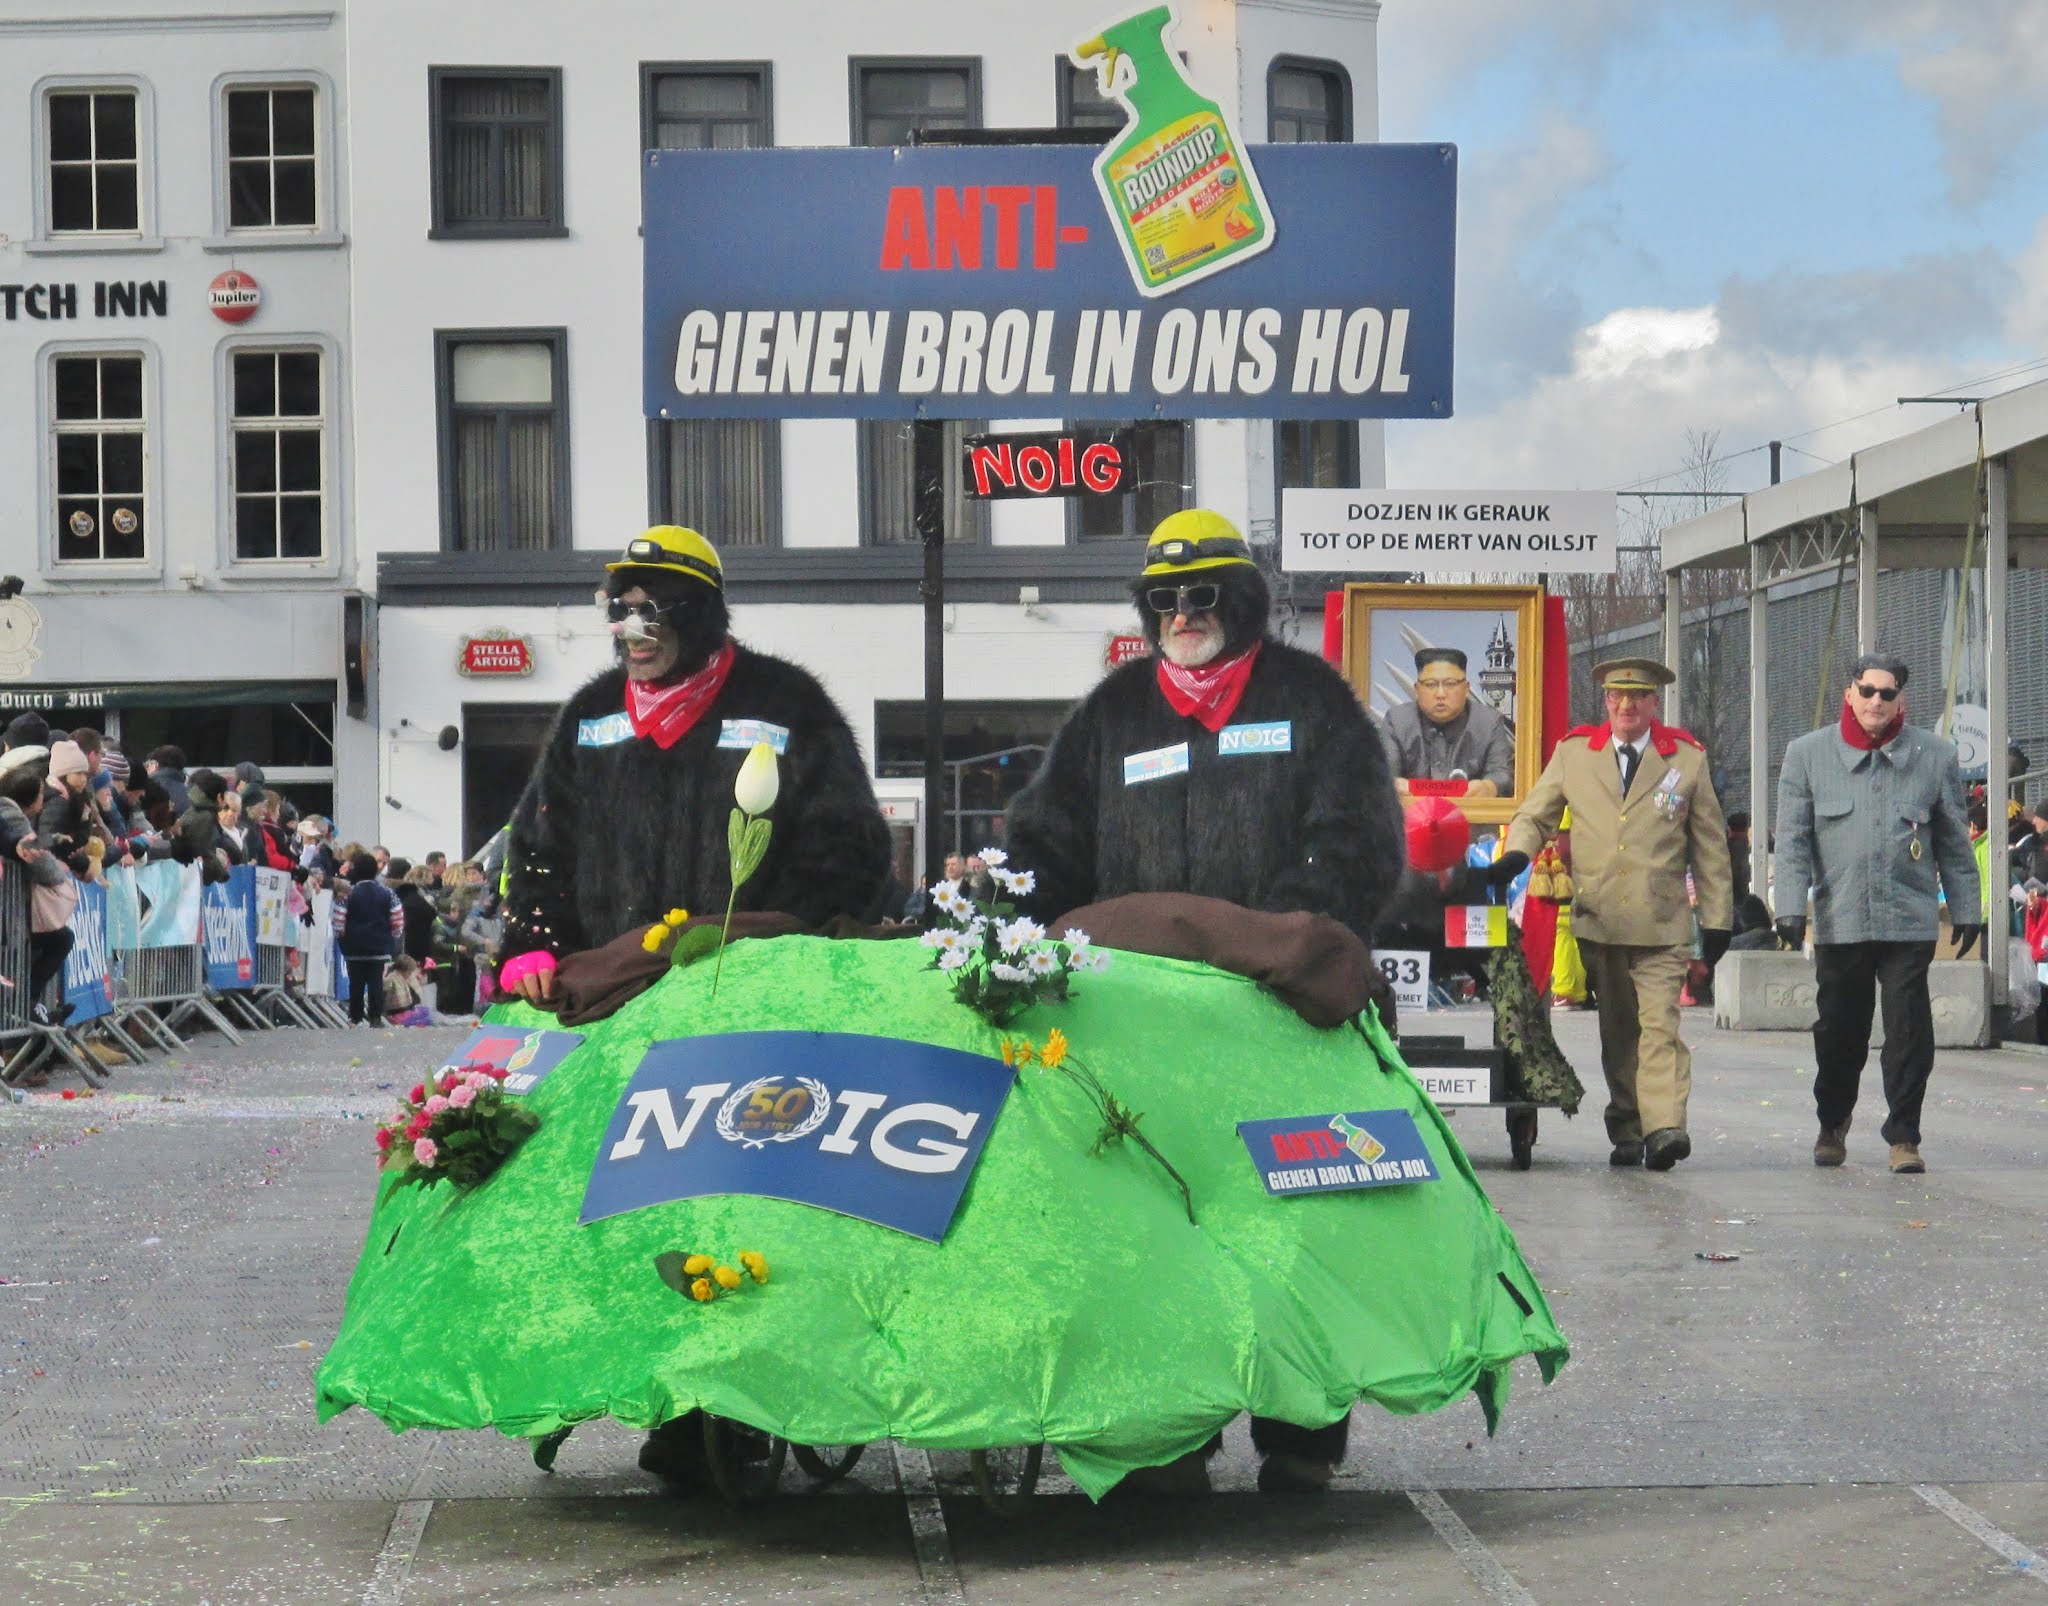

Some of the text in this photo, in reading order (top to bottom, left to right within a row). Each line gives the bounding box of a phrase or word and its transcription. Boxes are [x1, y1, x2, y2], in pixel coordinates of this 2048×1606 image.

[1163, 124, 1200, 152] Action
[1123, 128, 1216, 211] ROUNDUP
[1141, 158, 1220, 215] WEEDKILLER
[879, 185, 1088, 271] ANTI-
[0, 280, 167, 320] TCH INN
[211, 291, 257, 305] Jupiler
[675, 308, 1411, 395] GIENEN BROL IN ONS HOL
[971, 438, 1122, 495] NOIG
[1348, 504, 1551, 522] DOZJEN IK GERAUK
[1300, 532, 1598, 552] TOT OP DE MERT VAN OILSJT
[472, 645, 519, 655] STELLA
[1117, 641, 1146, 651] STEL
[473, 656, 521, 666] ARTOIS
[1380, 958, 1421, 985] 83
[1396, 994, 1422, 1002] EMET
[743, 1086, 808, 1120] 50
[1267, 1159, 1430, 1190] GIENEN BROL IN ONS HOL
